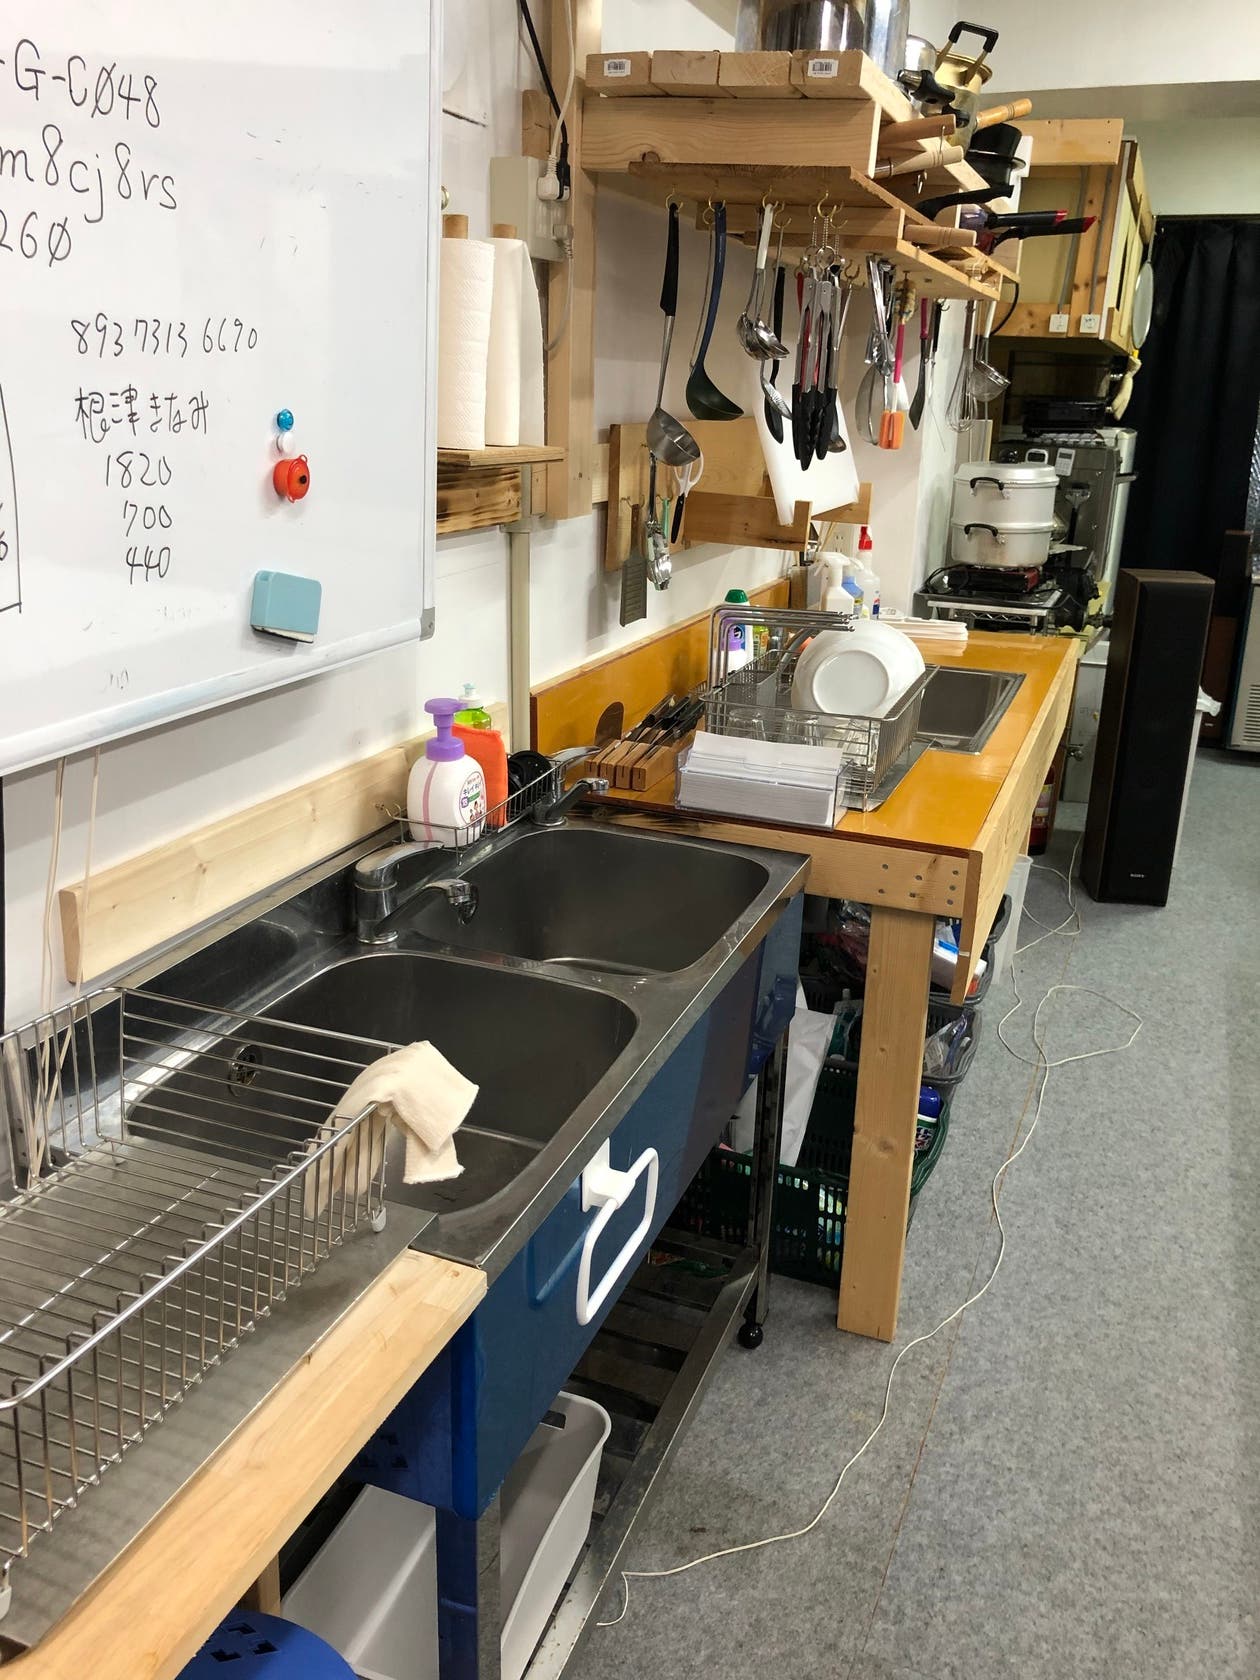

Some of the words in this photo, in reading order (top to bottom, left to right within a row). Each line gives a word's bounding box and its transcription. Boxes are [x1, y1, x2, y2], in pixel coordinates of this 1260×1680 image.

[106, 450, 172, 488] 1820
[123, 500, 172, 537] 700
[126, 545, 171, 585] 440
